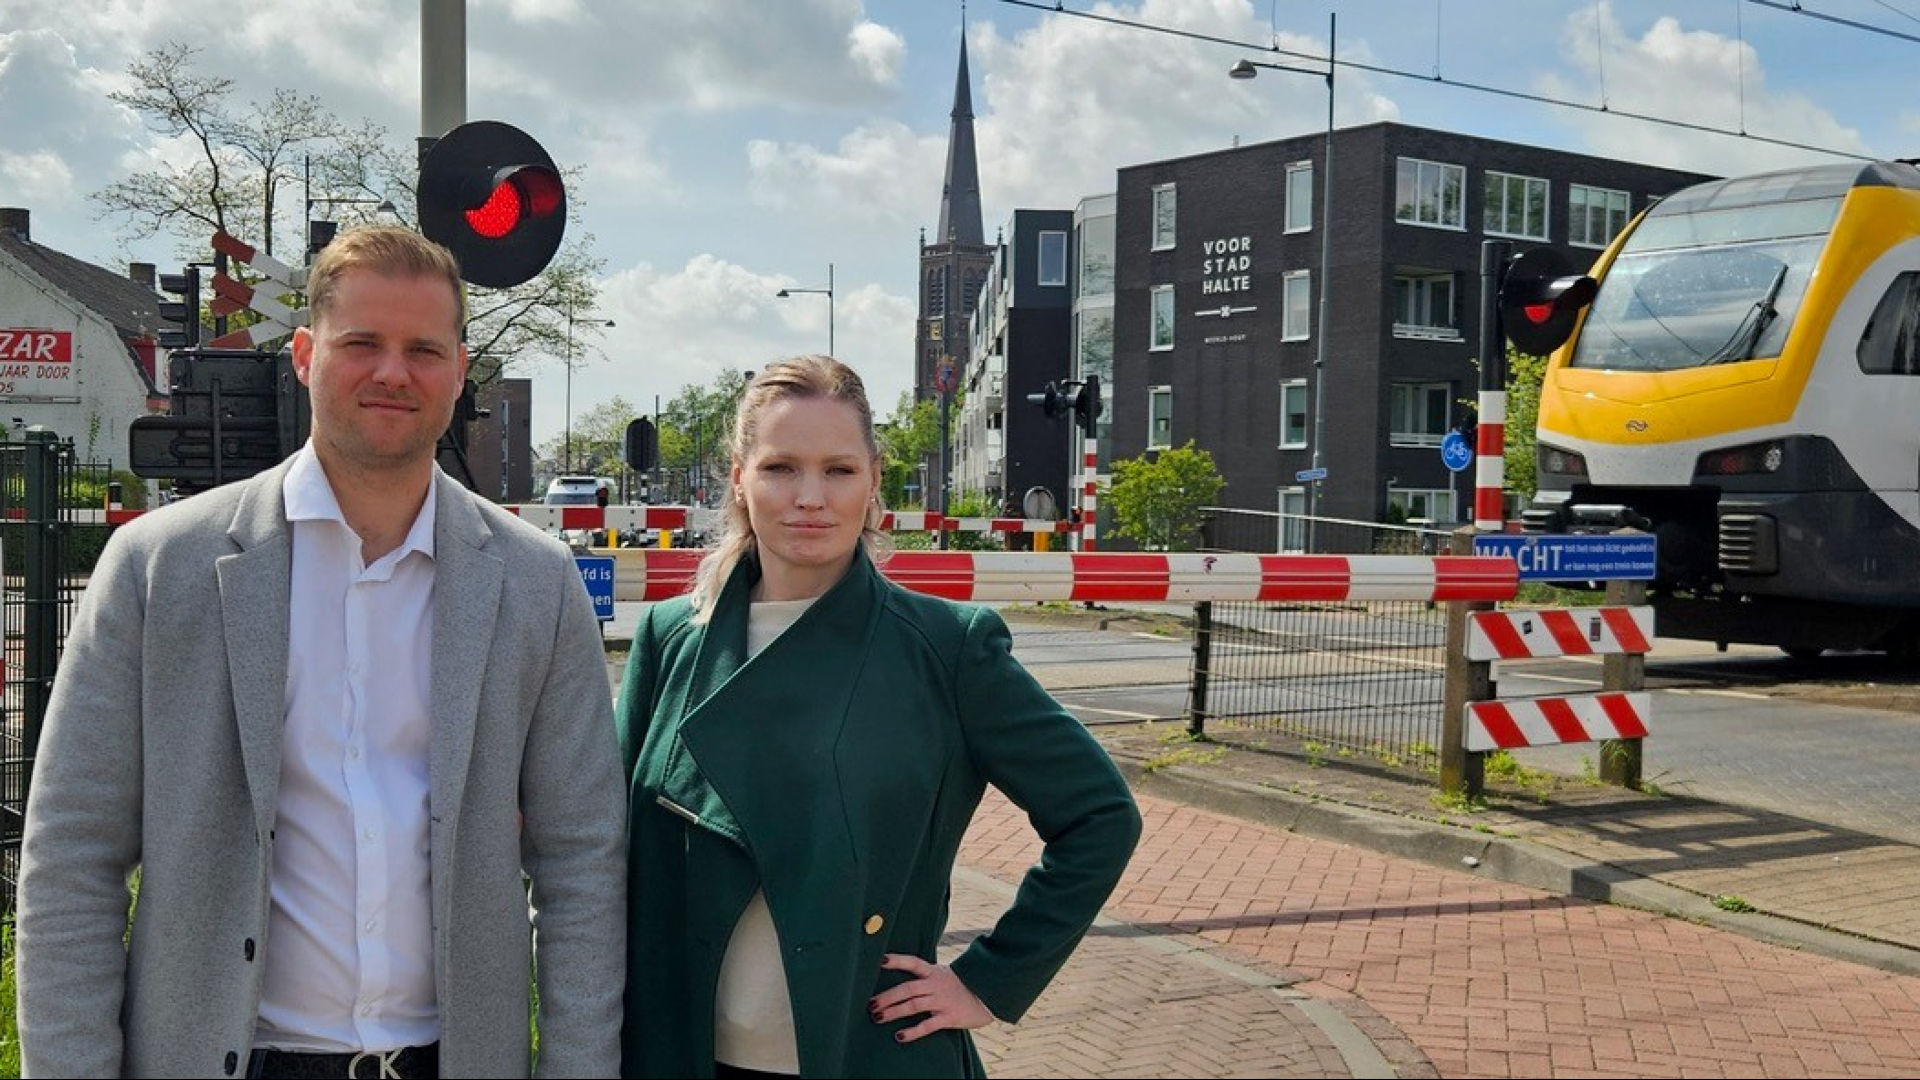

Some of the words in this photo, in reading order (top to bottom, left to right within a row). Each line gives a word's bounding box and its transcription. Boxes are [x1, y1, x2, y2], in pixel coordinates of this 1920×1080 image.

[1203, 236, 1250, 255] VOOR
[1203, 256, 1250, 274] STAD
[1203, 276, 1250, 294] HALTE
[0, 332, 57, 361] ZAR
[37, 365, 70, 380] DOOR
[600, 566, 611, 580] is
